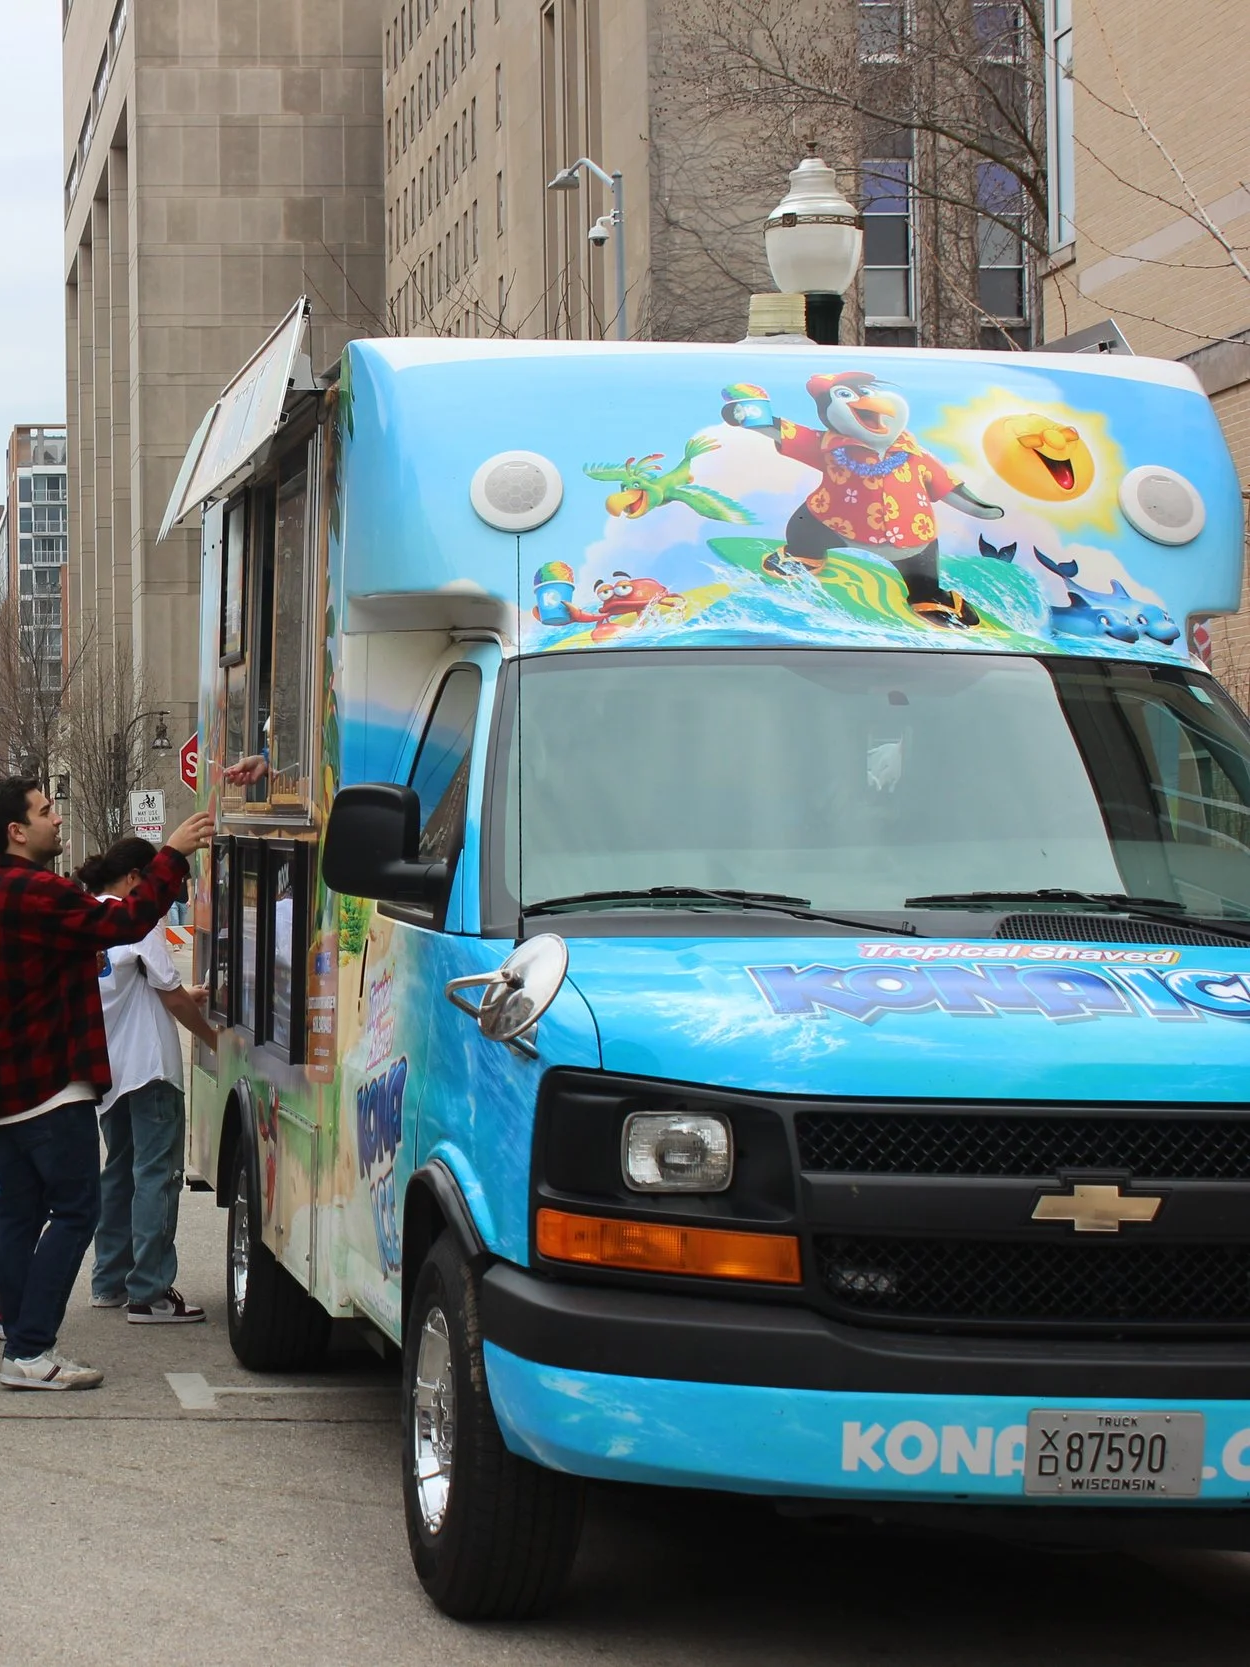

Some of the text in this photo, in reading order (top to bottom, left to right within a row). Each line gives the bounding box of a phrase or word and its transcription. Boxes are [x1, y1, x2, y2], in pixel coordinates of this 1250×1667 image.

[863, 943, 1175, 964] Tropical Shaved
[744, 963, 1250, 1022] KONA IC
[356, 1055, 407, 1181] KONA
[370, 1166, 401, 1281] ICE
[1098, 1416, 1139, 1428] TRUCK
[1066, 1432, 1166, 1474] 87590
[1071, 1478, 1156, 1491] WISCONSIN
